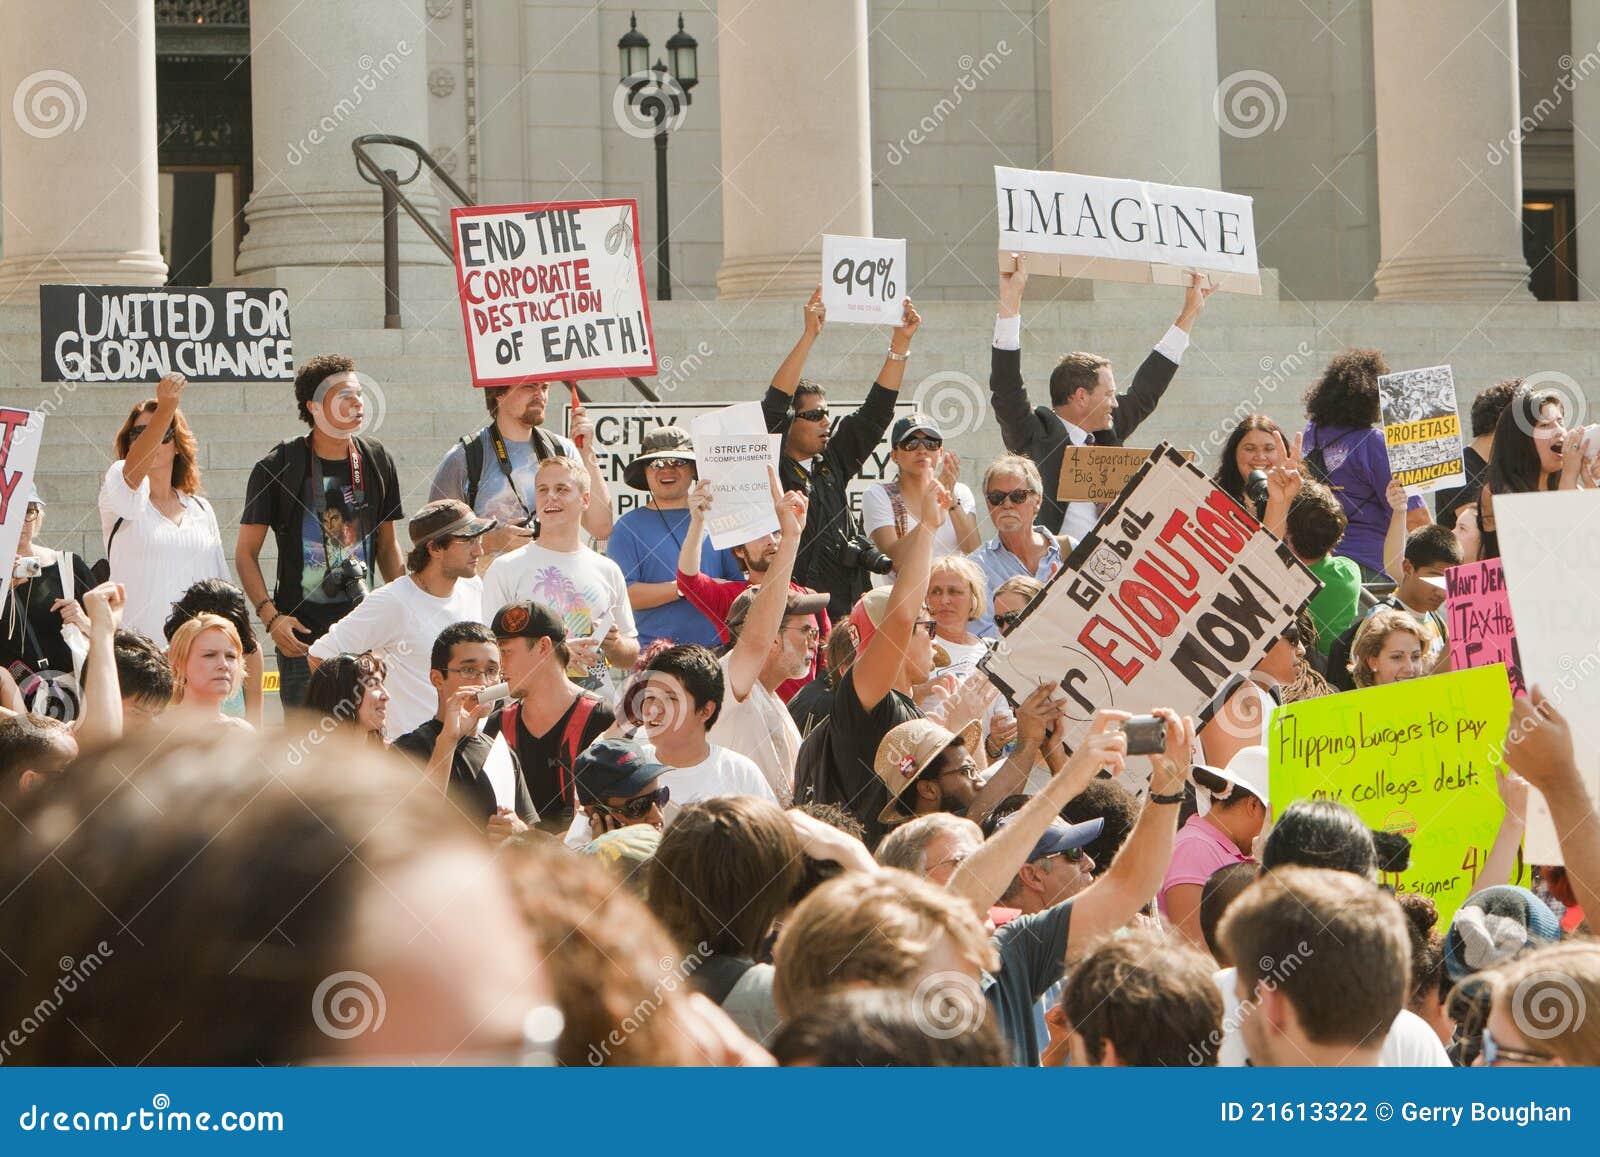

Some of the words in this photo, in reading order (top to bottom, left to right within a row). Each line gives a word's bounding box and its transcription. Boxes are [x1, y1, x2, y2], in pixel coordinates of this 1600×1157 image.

[460, 219, 526, 267] END
[524, 208, 586, 256] THE
[1001, 187, 1246, 256] IMAGINE
[464, 258, 592, 305] CORPORATE
[832, 257, 896, 302] 99%
[78, 292, 215, 342] UNITED
[226, 289, 291, 338] FOR
[473, 289, 602, 336] DESTRUCTION
[175, 337, 295, 379] CHANGE
[495, 330, 524, 365] OF
[541, 310, 649, 363] EARTH!
[714, 445, 747, 454] STRIVE
[748, 444, 768, 453] FOR
[1386, 418, 1456, 443] PROFETAS!
[1170, 563, 1298, 699] NOW!
[1277, 713, 1356, 768] Flipping
[1359, 711, 1424, 756] burgers
[1427, 711, 1449, 738] to
[1457, 717, 1488, 744] pay
[1351, 769, 1422, 805] college
